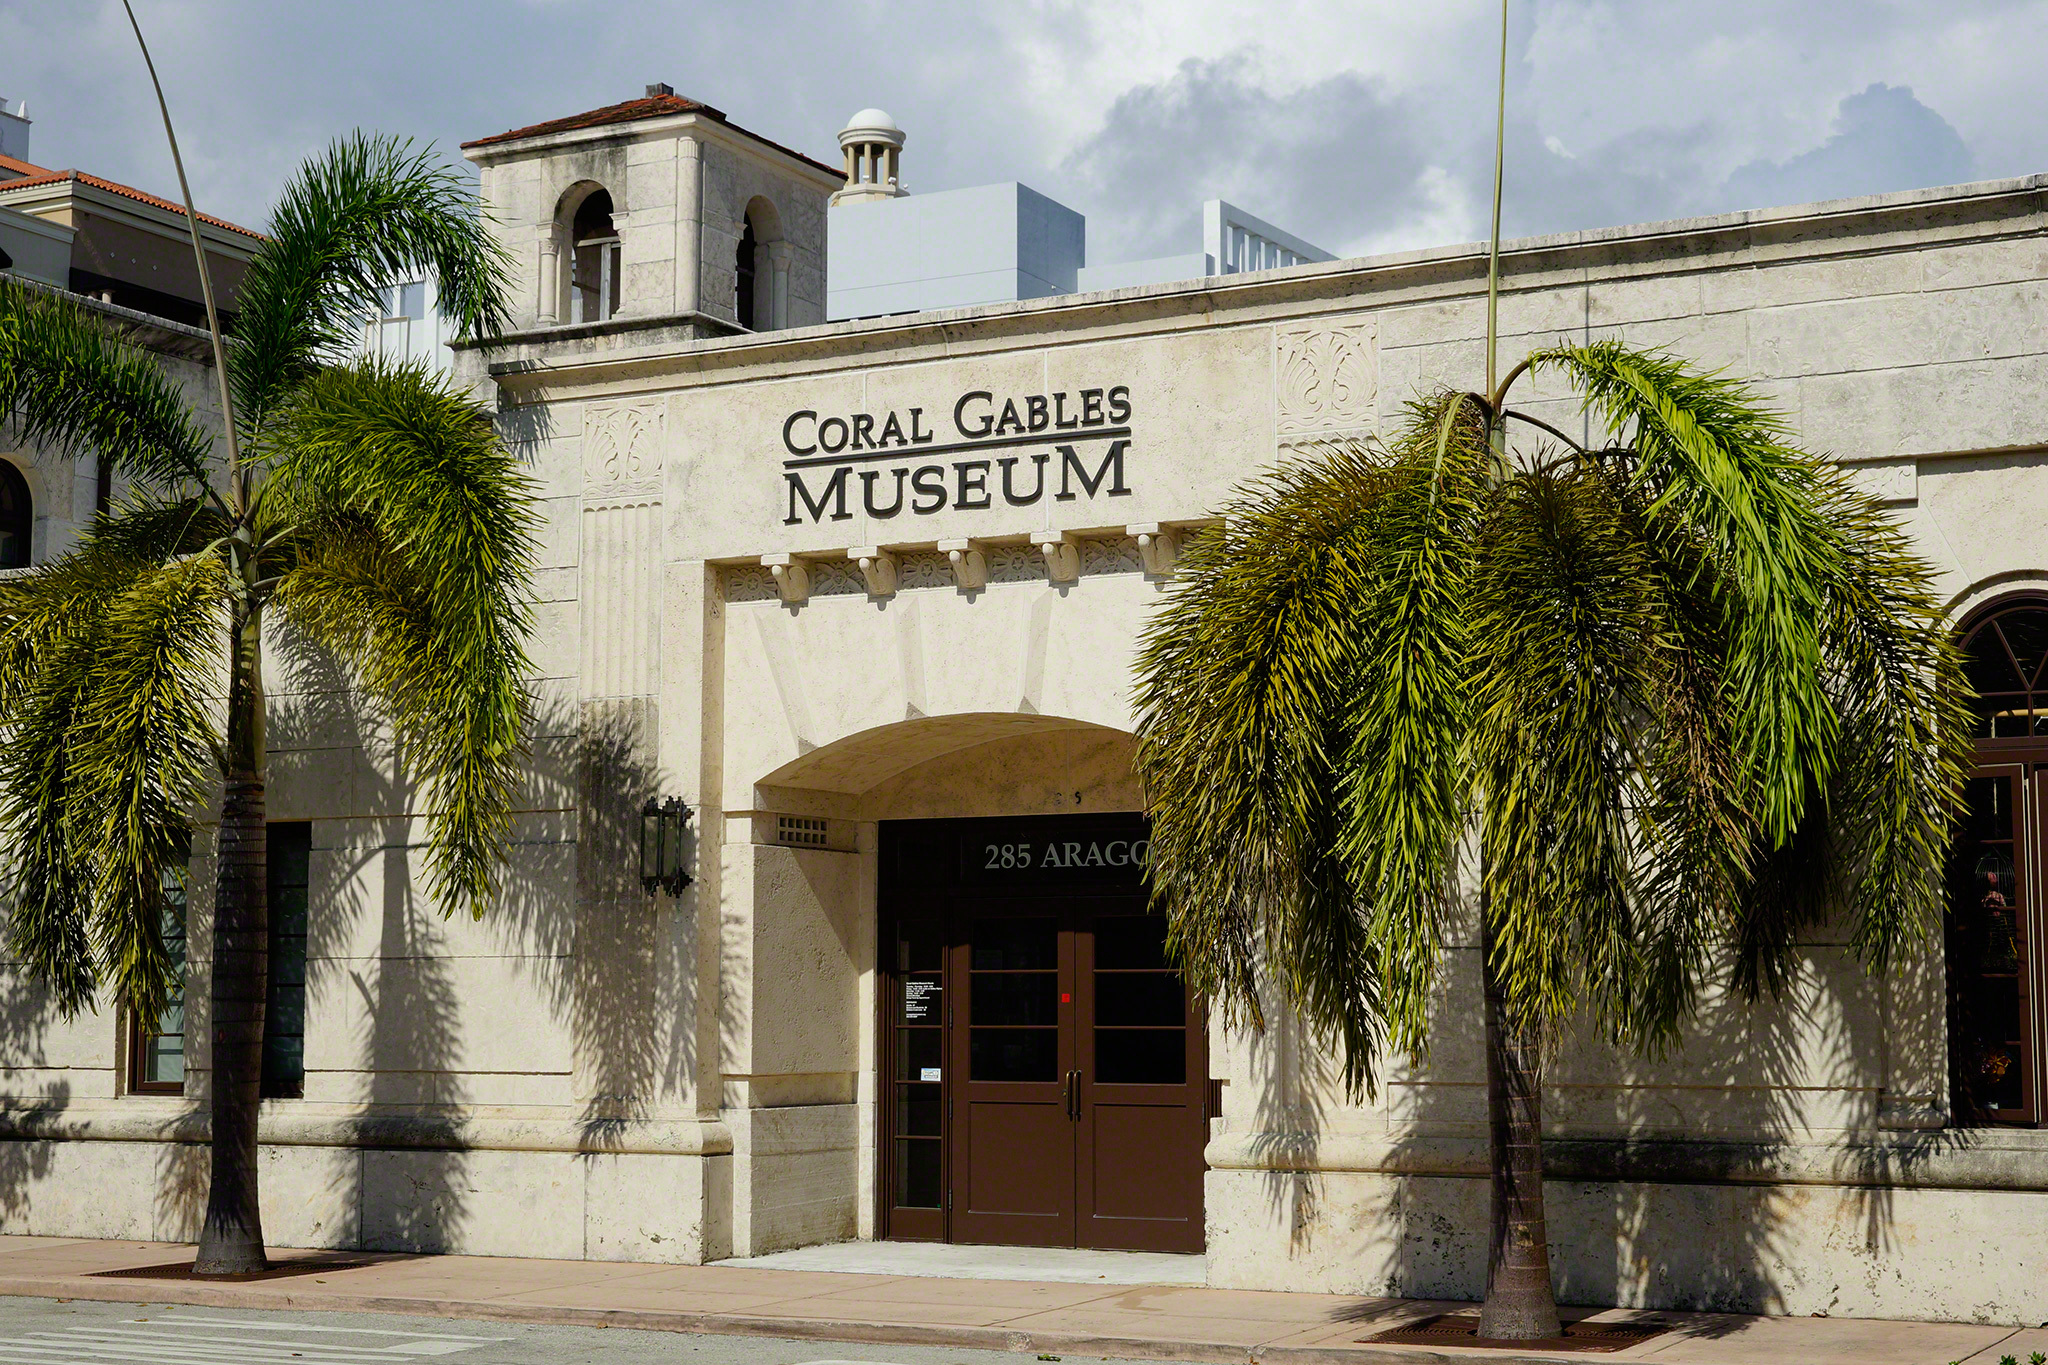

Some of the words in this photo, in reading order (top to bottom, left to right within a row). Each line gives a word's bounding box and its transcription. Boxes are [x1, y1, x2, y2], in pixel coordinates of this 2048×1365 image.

[783, 408, 933, 456] CORAL
[954, 385, 1132, 438] GABLES
[783, 440, 1132, 526] MUSEUM
[985, 844, 1031, 869] 285
